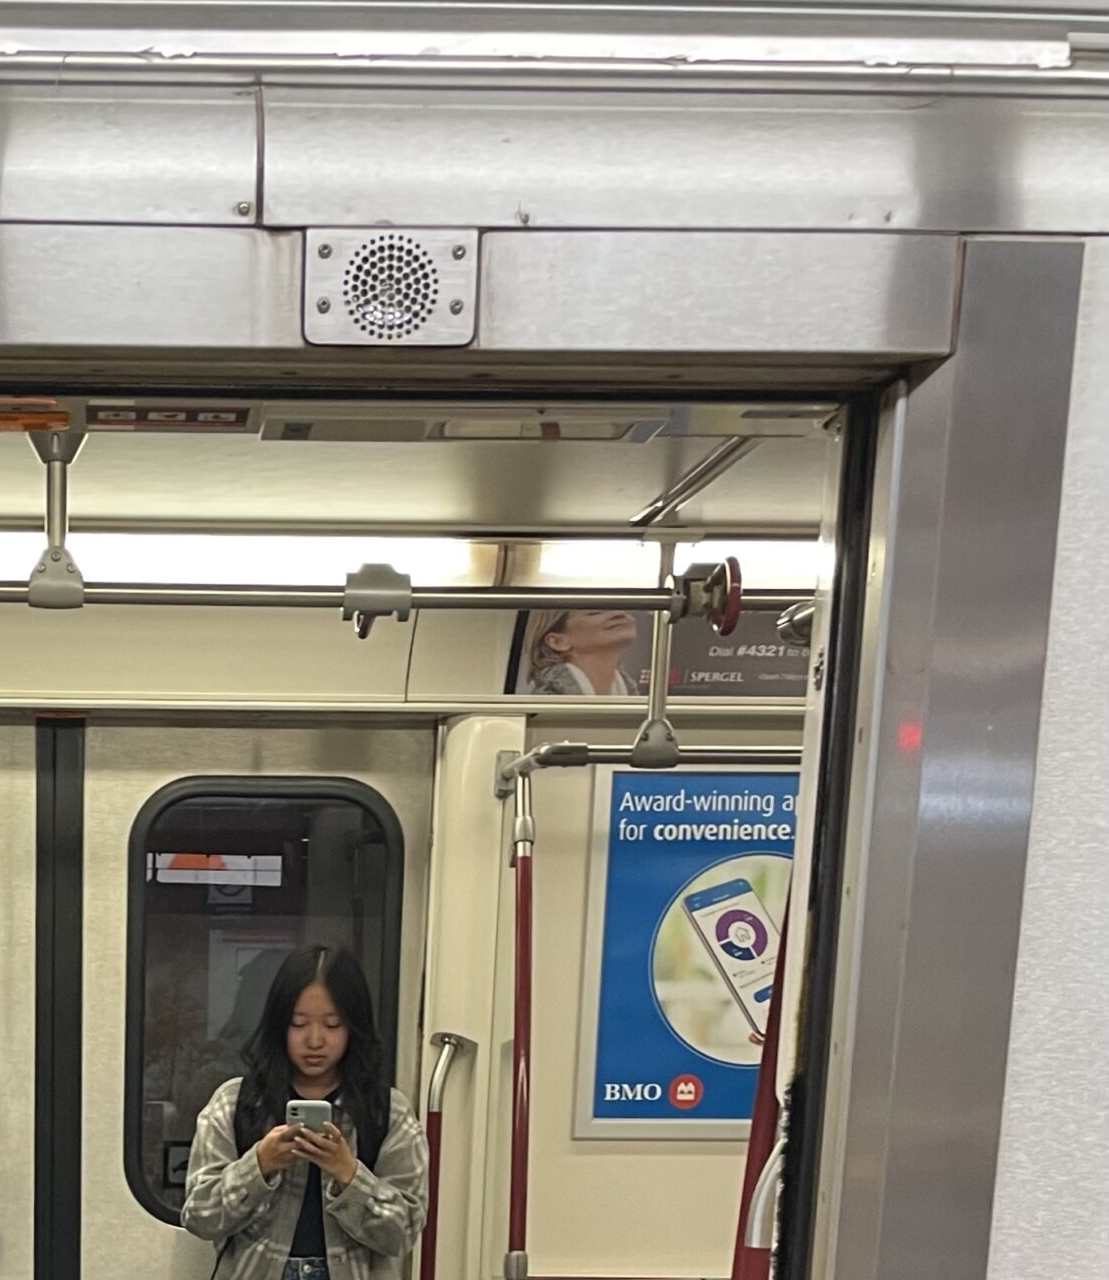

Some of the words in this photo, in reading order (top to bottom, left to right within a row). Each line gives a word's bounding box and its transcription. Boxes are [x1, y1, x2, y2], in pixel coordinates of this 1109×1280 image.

[708, 645, 734, 657] Dial
[736, 645, 785, 657] #4321
[690, 671, 744, 682] SPERGEL
[619, 789, 775, 817] Award-winning
[619, 818, 648, 841] for
[653, 819, 795, 841] convenience.
[604, 1083, 662, 1101] BMO
